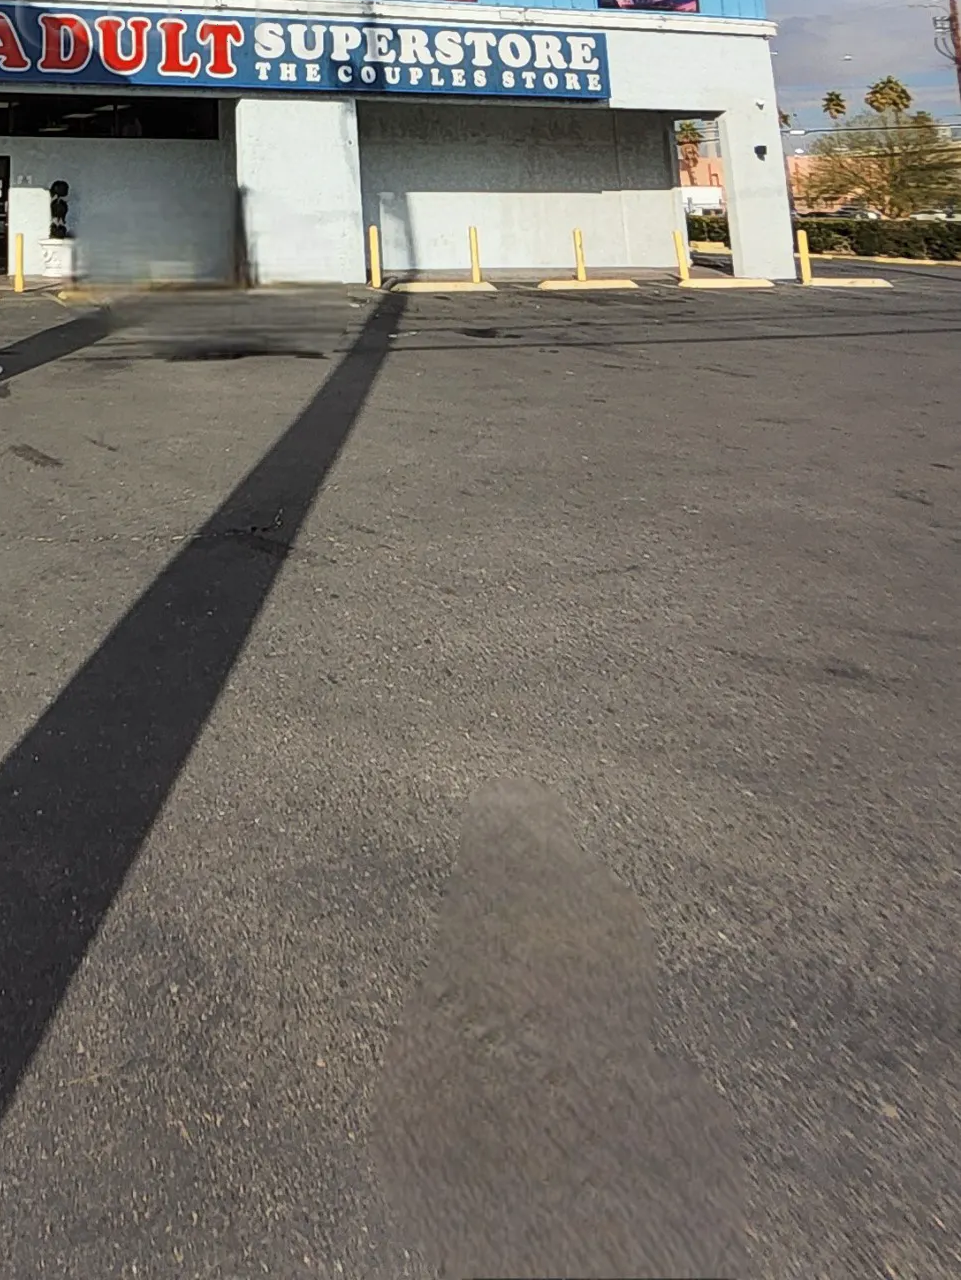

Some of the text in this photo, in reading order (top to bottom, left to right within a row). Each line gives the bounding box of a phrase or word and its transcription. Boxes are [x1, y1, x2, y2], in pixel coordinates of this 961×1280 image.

[253, 22, 600, 72] SUPERSTORE
[254, 60, 603, 92] THE COUPLES STORE
